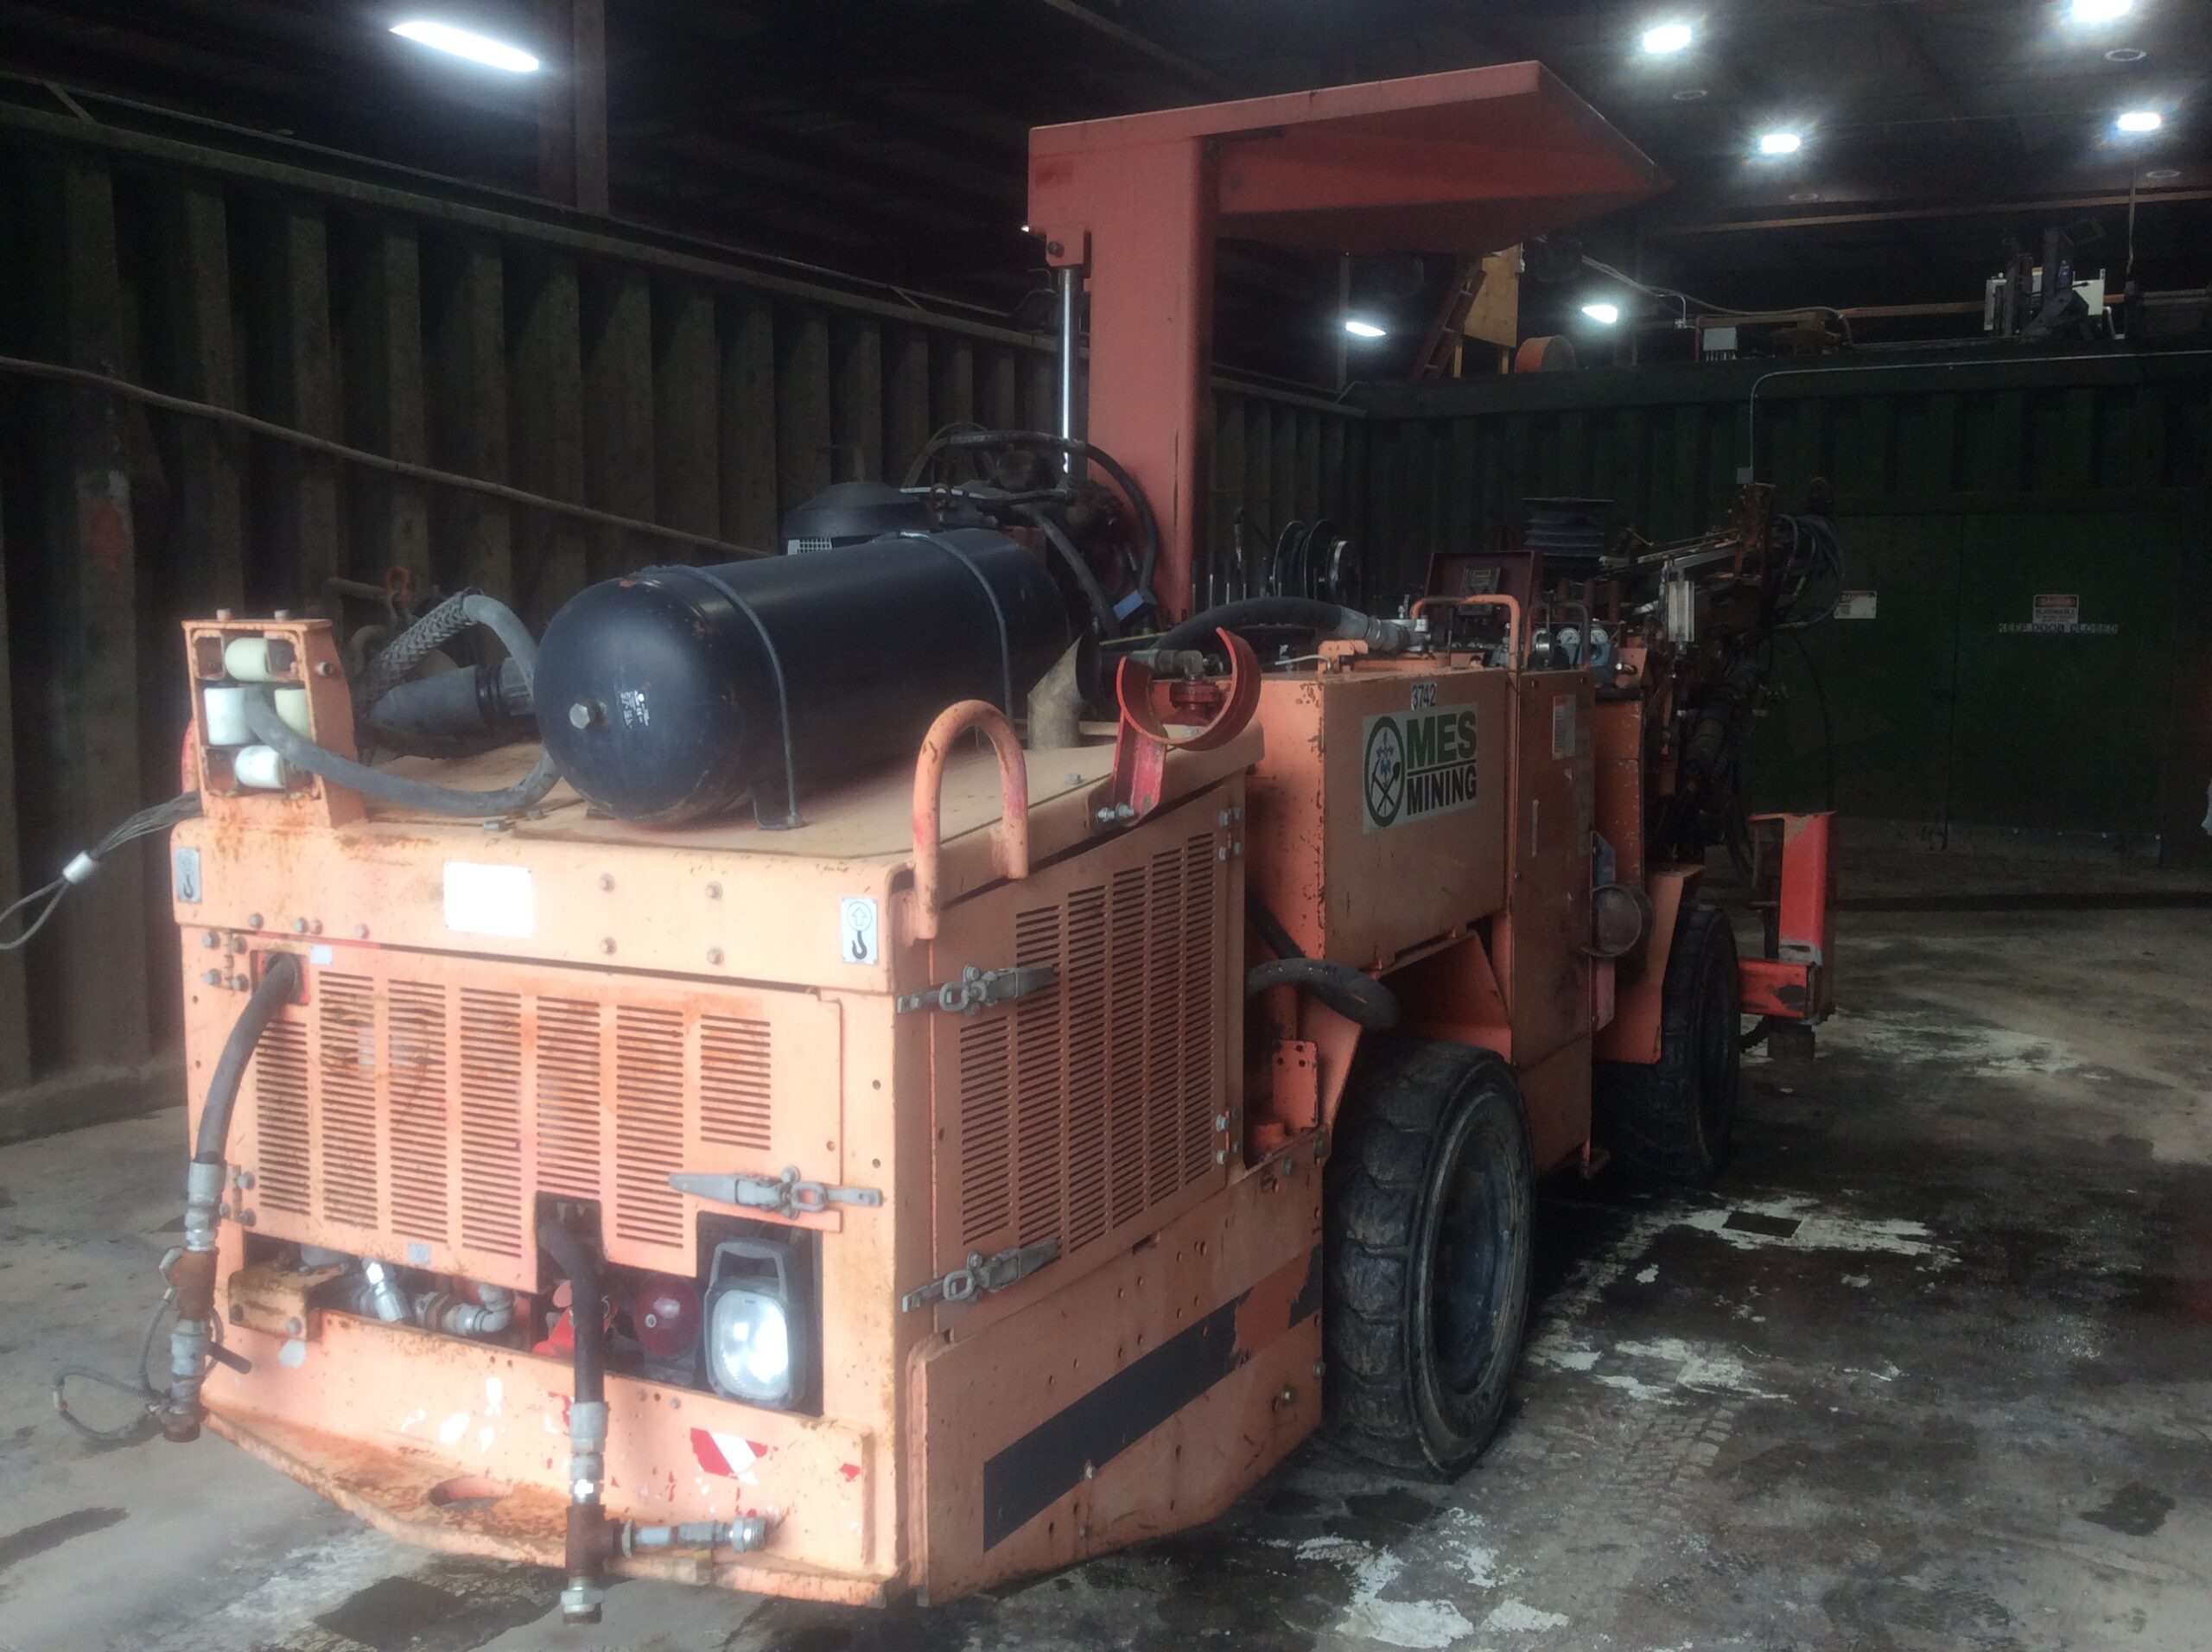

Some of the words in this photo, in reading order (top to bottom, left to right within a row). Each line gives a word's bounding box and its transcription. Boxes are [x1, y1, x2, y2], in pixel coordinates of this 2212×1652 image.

[1998, 623, 2027, 632] KEEP
[2031, 623, 2064, 632] DOOR
[2070, 623, 2117, 633] CLOSED
[1412, 683, 1436, 709] 3742
[1407, 710, 1477, 768] MES
[1407, 766, 1477, 815] MINING
